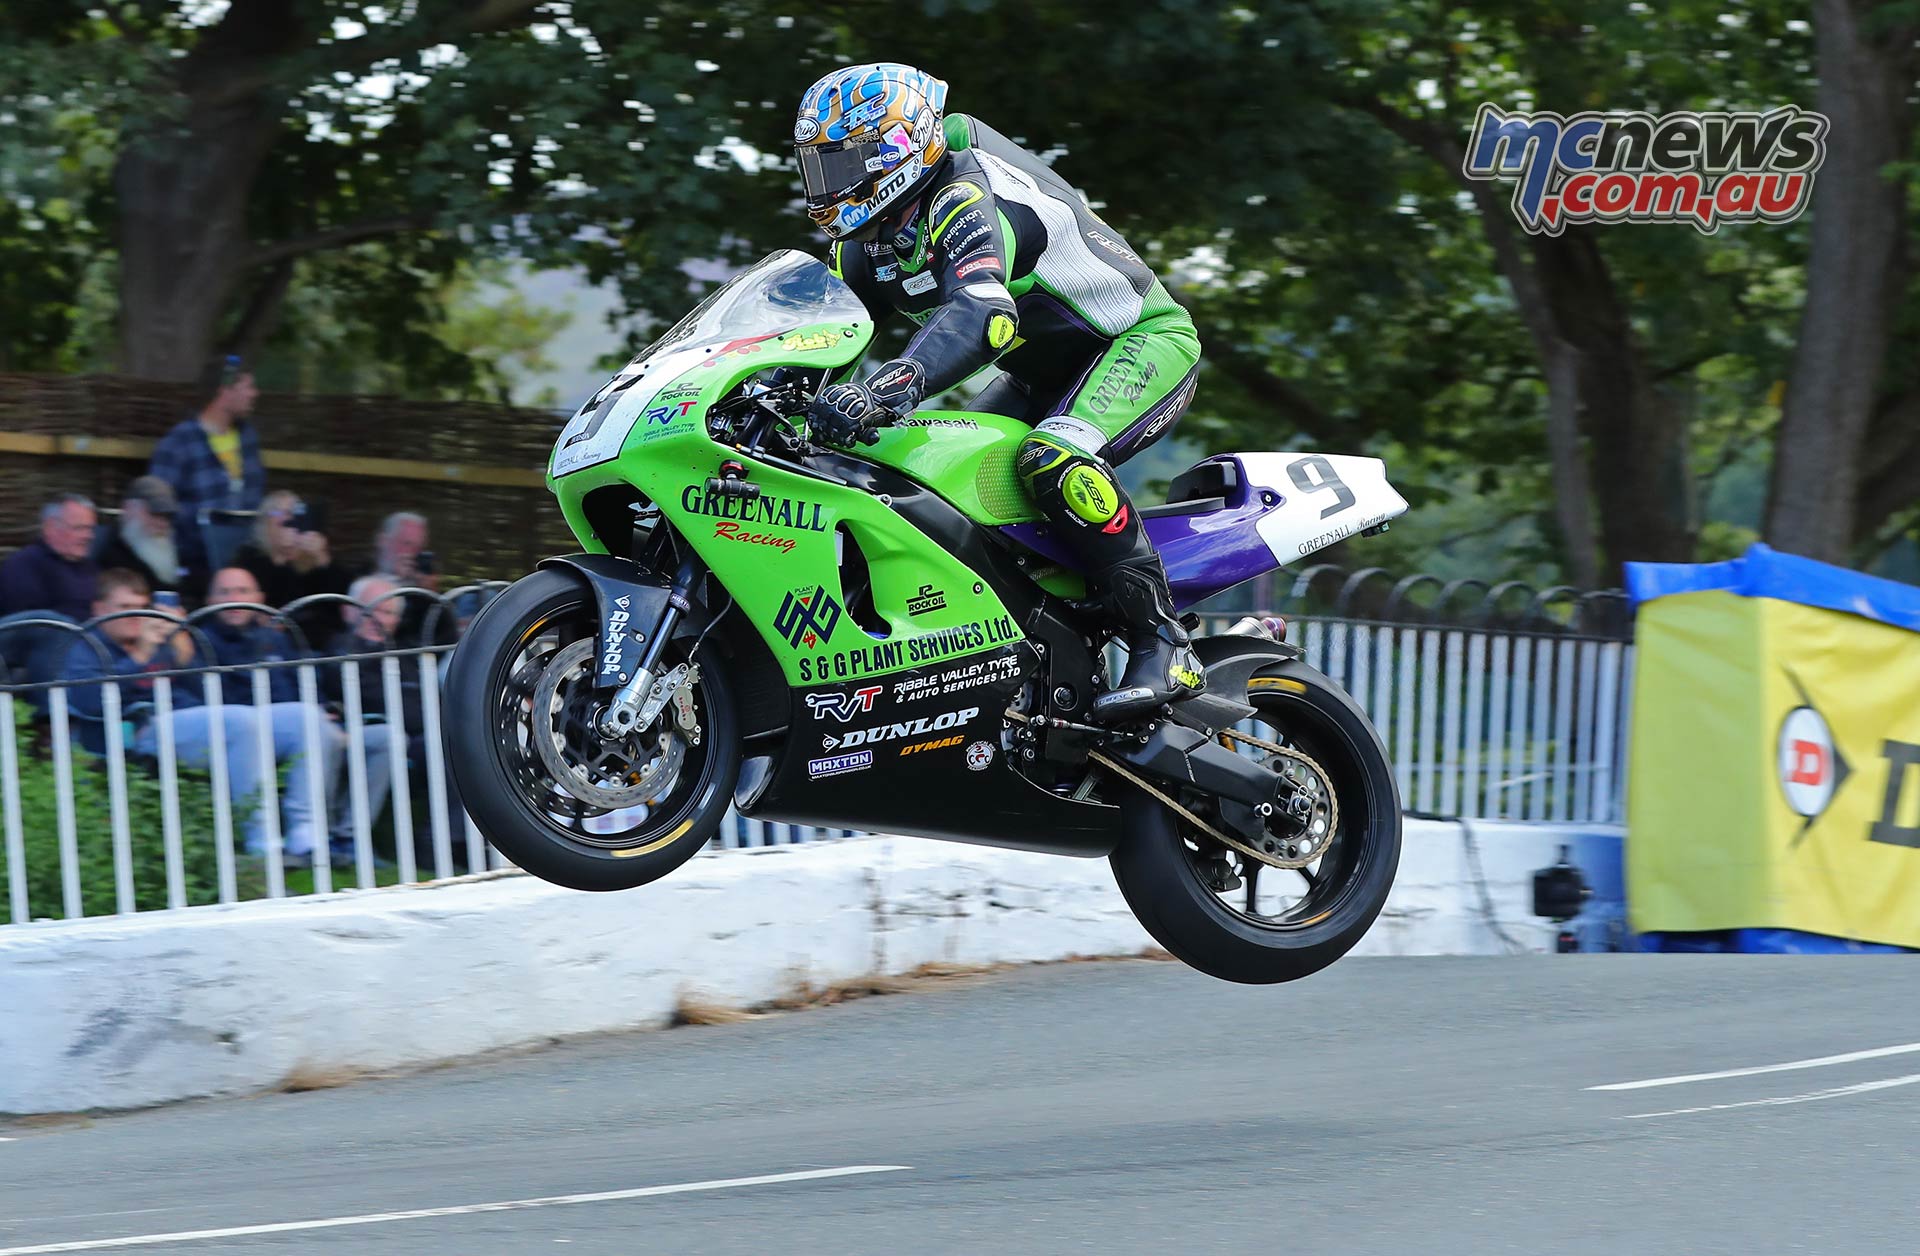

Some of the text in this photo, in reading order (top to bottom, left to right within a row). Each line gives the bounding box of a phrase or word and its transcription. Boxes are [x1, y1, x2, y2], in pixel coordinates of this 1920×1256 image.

[949, 224, 993, 260] Kawasaki
[1087, 231, 1143, 265] RST
[661, 393, 683, 402] ROCK
[896, 416, 979, 431] Kawasaki
[1286, 455, 1355, 520] 9
[682, 485, 828, 532] GREENALL
[713, 521, 796, 554] Racing
[1298, 513, 1385, 555] GREENALL Racing
[794, 585, 814, 595] PLANT
[908, 597, 946, 613] ROCK OIL
[601, 610, 630, 675] DUNLOP
[800, 614, 1018, 682] S & G PLANT SERVICES Ltd.
[893, 654, 1018, 694] RIBBLE VALLEY TYRE
[896, 667, 1021, 704] & AUTO SERVICES LTD
[839, 706, 980, 749] DUNLOP
[811, 753, 870, 773] MAXTON
[900, 735, 965, 757] DYMAG
